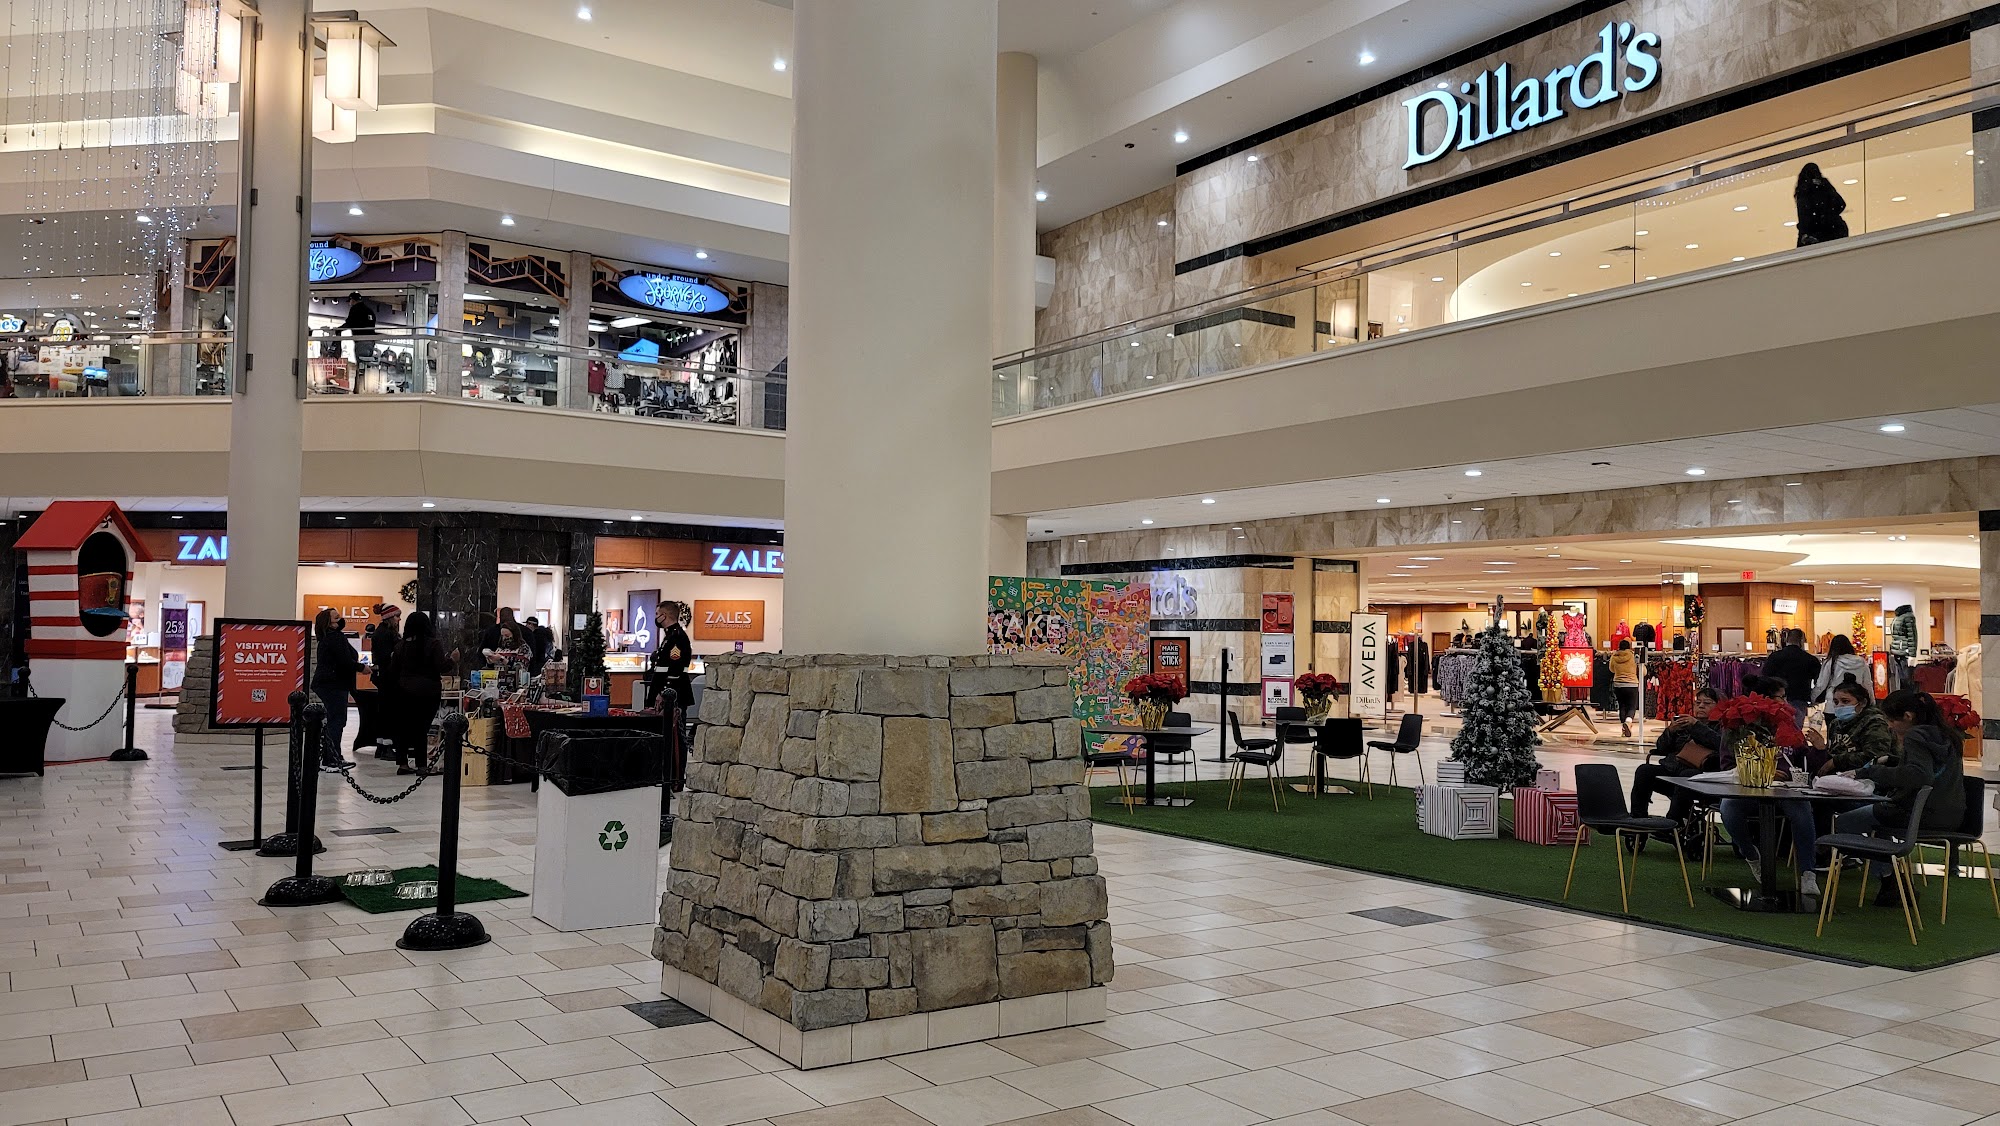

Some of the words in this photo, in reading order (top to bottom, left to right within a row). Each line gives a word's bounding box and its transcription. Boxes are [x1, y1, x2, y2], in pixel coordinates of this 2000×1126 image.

[1401, 21, 1661, 170] Dillard's
[646, 273, 671, 281] under
[672, 274, 698, 284] ground
[711, 548, 784, 573] ZALE
[318, 606, 370, 619] LES
[705, 612, 752, 624] ZALES
[235, 642, 260, 650] VISIT
[262, 643, 287, 651] WITH
[234, 652, 288, 664] SANTA
[1161, 655, 1179, 666] STICK
[1362, 622, 1376, 689] AVEDA
